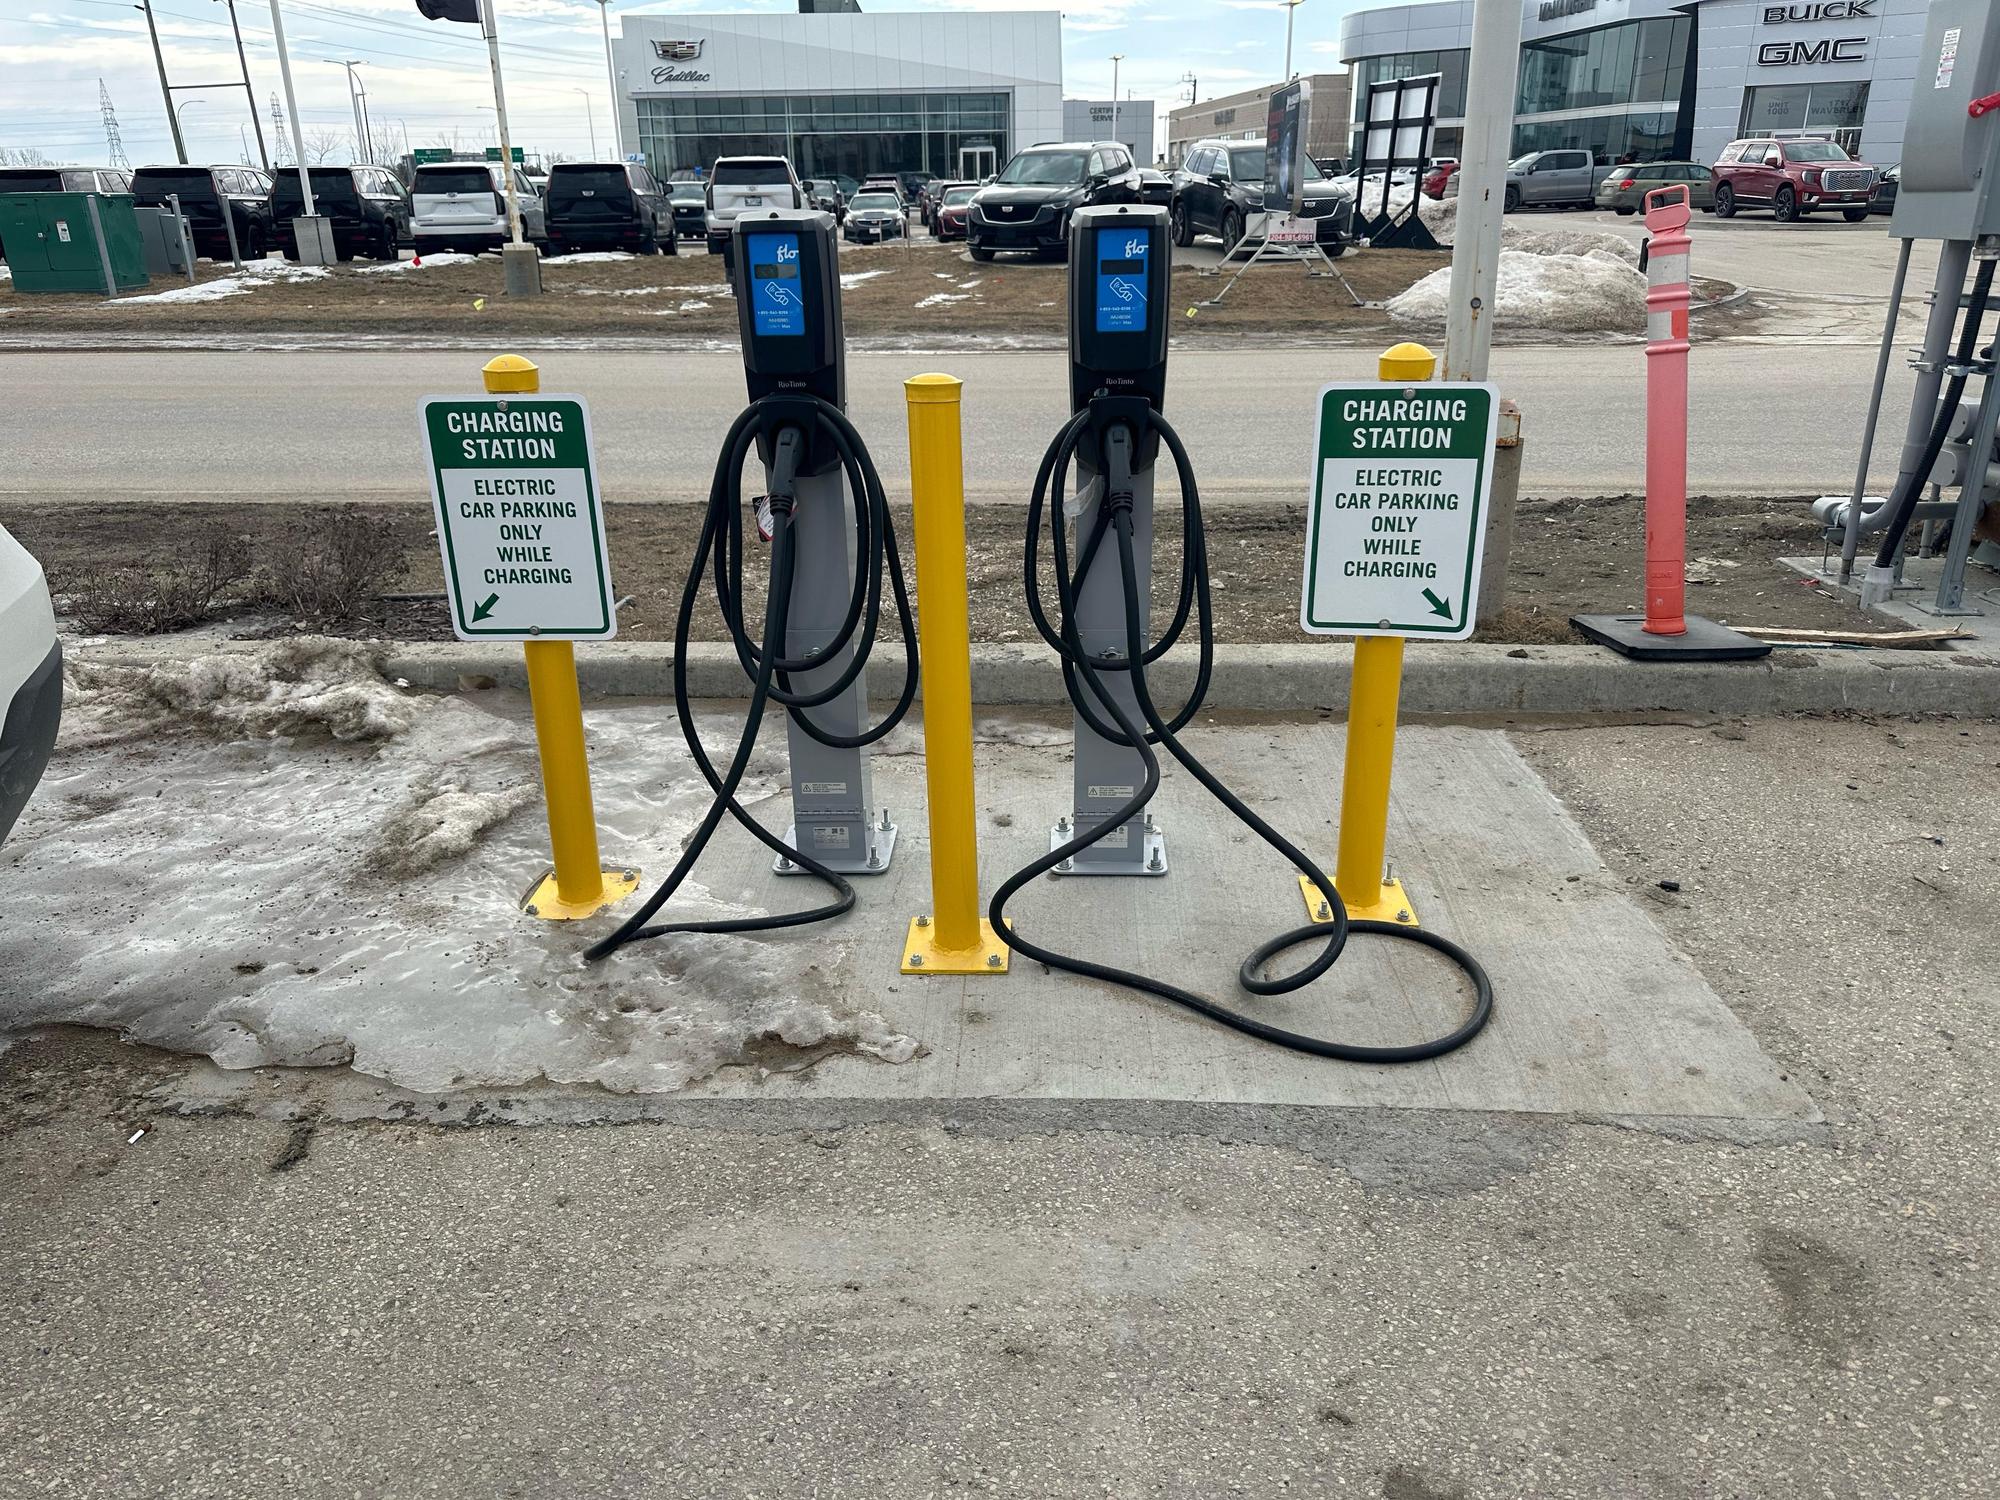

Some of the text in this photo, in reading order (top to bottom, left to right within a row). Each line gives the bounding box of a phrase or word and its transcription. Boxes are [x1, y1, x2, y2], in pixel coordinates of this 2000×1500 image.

[1763, 0, 1877, 24] BUICK
[1757, 36, 1868, 66] GMC
[651, 65, 710, 84] Cadillac
[1089, 107, 1122, 115] CERTIFID
[777, 244, 799, 262] flo
[1125, 239, 1148, 257] flo
[1343, 399, 1467, 422] CHARGING
[447, 411, 564, 434] CHARGING
[1352, 427, 1452, 449] STATION
[462, 438, 556, 460] STATION
[1355, 469, 1443, 487] ELECTRIC
[474, 479, 556, 496] ELECTRIC
[460, 502, 577, 519] CAR PARKING
[1335, 492, 1459, 511] CAR PARKING
[499, 524, 543, 541] ONLY
[1371, 515, 1418, 533] ONLY
[496, 546, 553, 563] WHILE
[1363, 538, 1422, 556] WHILE
[484, 568, 573, 585] CHARGING
[1343, 560, 1437, 579] CHARGING
